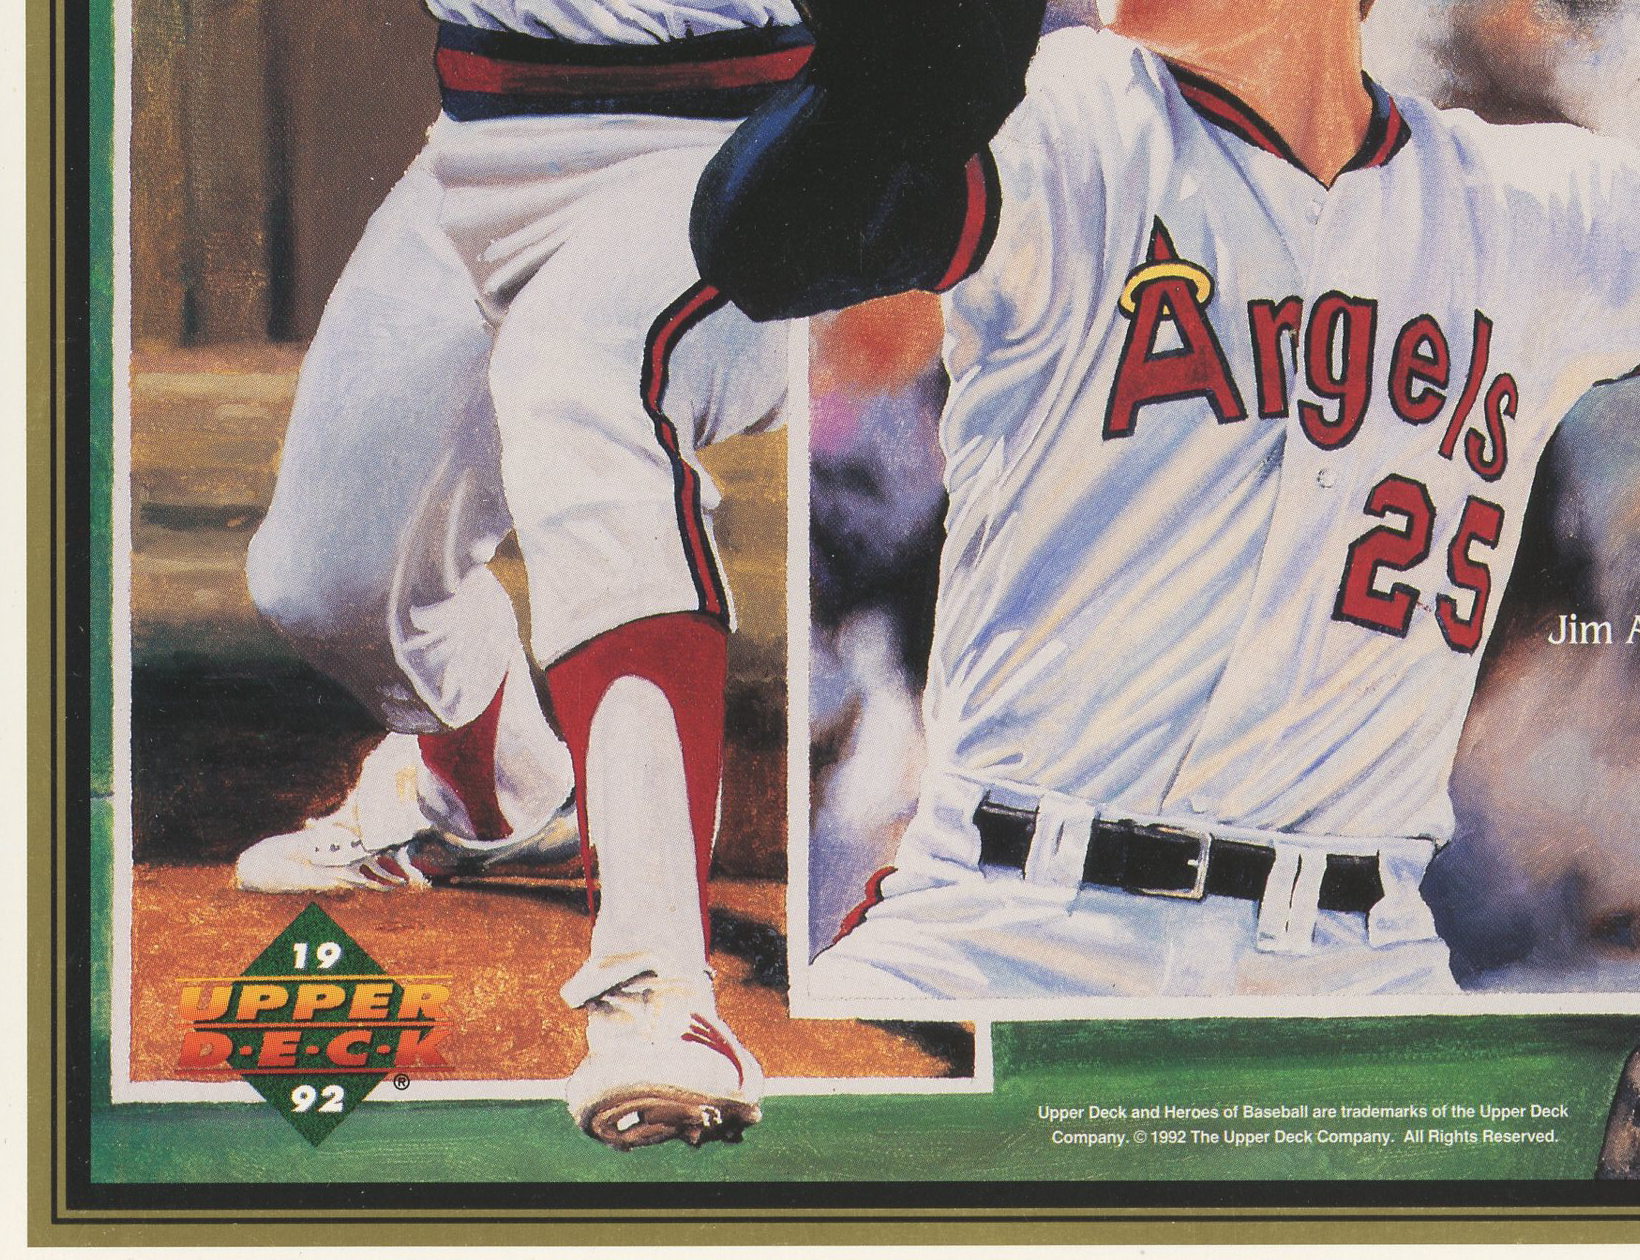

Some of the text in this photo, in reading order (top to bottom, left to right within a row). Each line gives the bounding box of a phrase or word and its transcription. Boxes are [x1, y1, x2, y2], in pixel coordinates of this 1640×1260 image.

[1331, 473, 1505, 656] 25
[1548, 614, 1613, 644] Jim
[293, 942, 341, 969] 19
[178, 983, 450, 1022] UPPER
[292, 1085, 345, 1113] 92
[1038, 1104, 1569, 1123] Upper Deck and Heroes of Baseball are trademarks of the Upper Deck
[1052, 1130, 1130, 1148] Company.
[1151, 1130, 1187, 1144] 1992
[1190, 1130, 1219, 1144] The
[1223, 1130, 1271, 1147] Upper
[1274, 1130, 1313, 1144] Deck
[1316, 1130, 1395, 1147] Company.
[1403, 1129, 1423, 1143] All
[1428, 1129, 1479, 1146] Rights
[1482, 1129, 1559, 1143] Reserved.
